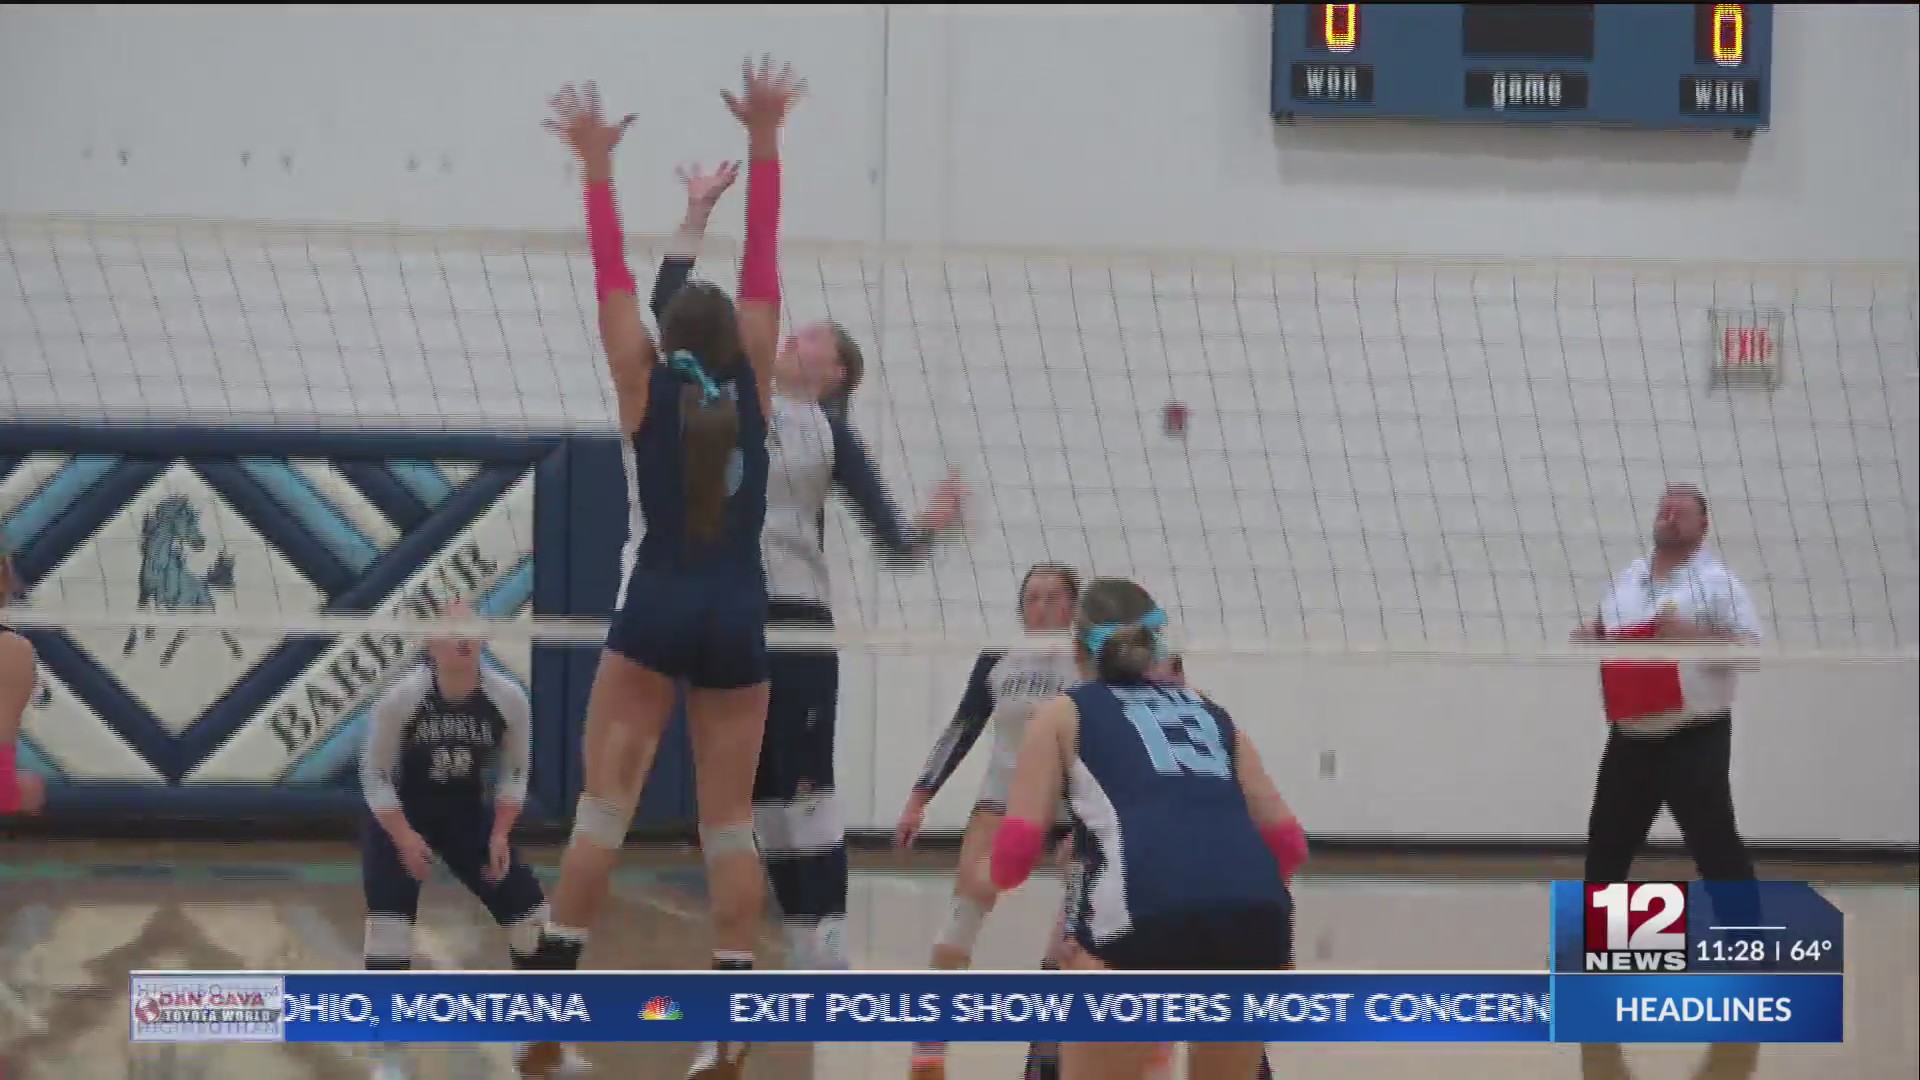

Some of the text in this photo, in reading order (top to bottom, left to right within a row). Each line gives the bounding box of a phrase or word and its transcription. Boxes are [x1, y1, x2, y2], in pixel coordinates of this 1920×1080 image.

[1712, 4, 1744, 67] 0
[1306, 66, 1357, 100] won
[1492, 72, 1562, 112] game
[1695, 79, 1745, 113] won
[1724, 327, 1769, 366] EXIT
[1001, 671, 1065, 698] REBEL
[1119, 699, 1233, 781] 13
